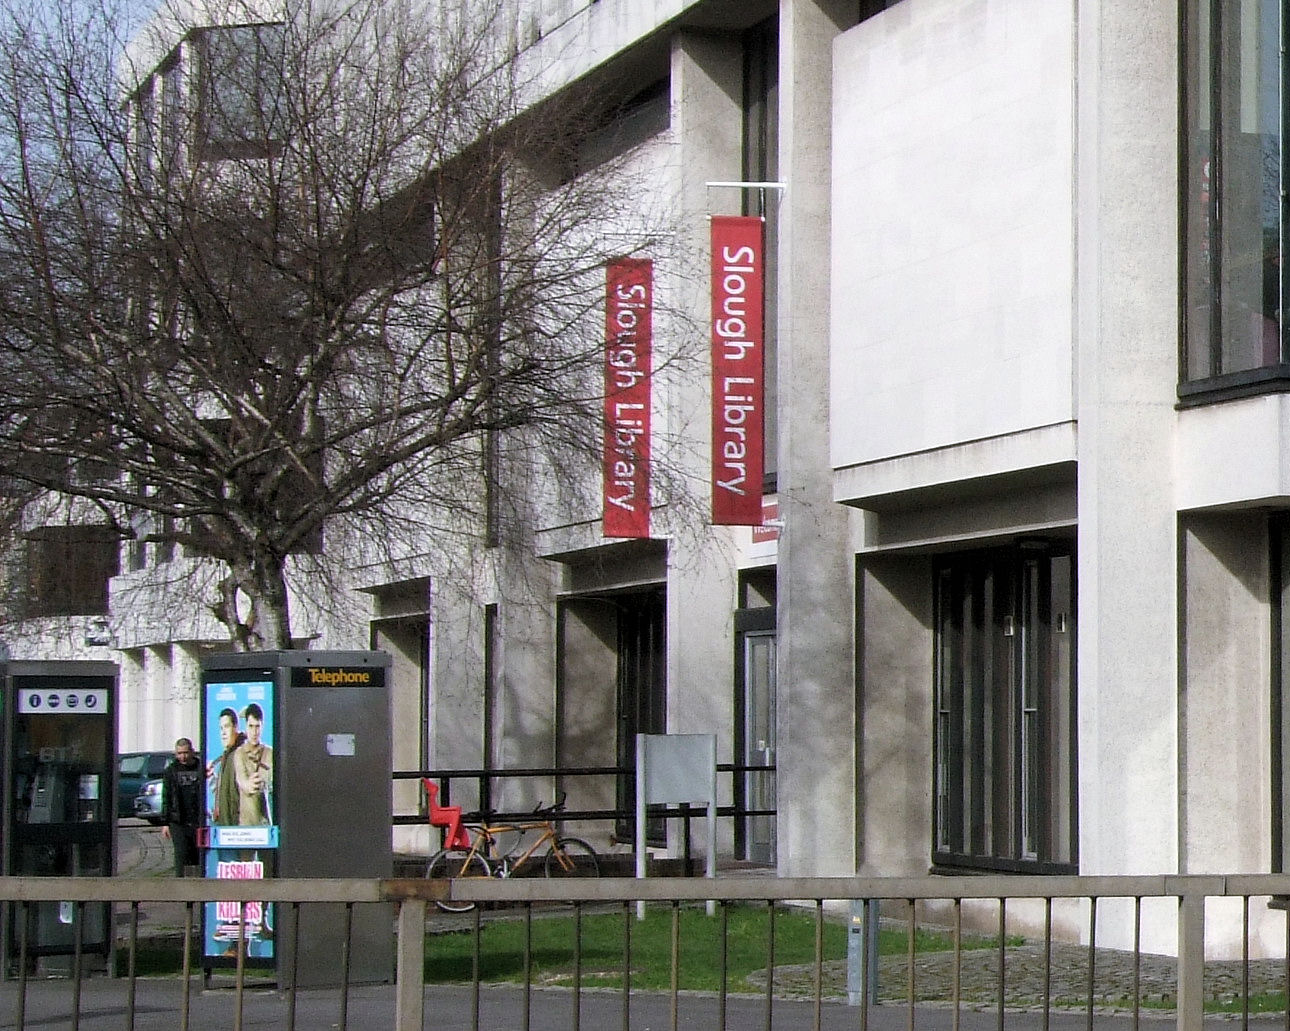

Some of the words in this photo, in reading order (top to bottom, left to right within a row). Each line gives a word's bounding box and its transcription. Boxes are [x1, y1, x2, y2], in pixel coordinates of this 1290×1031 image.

[609, 283, 646, 388] Slough
[716, 246, 755, 360] Slough
[607, 403, 644, 512] Library
[716, 377, 755, 496] Library
[308, 668, 370, 686] Telephone
